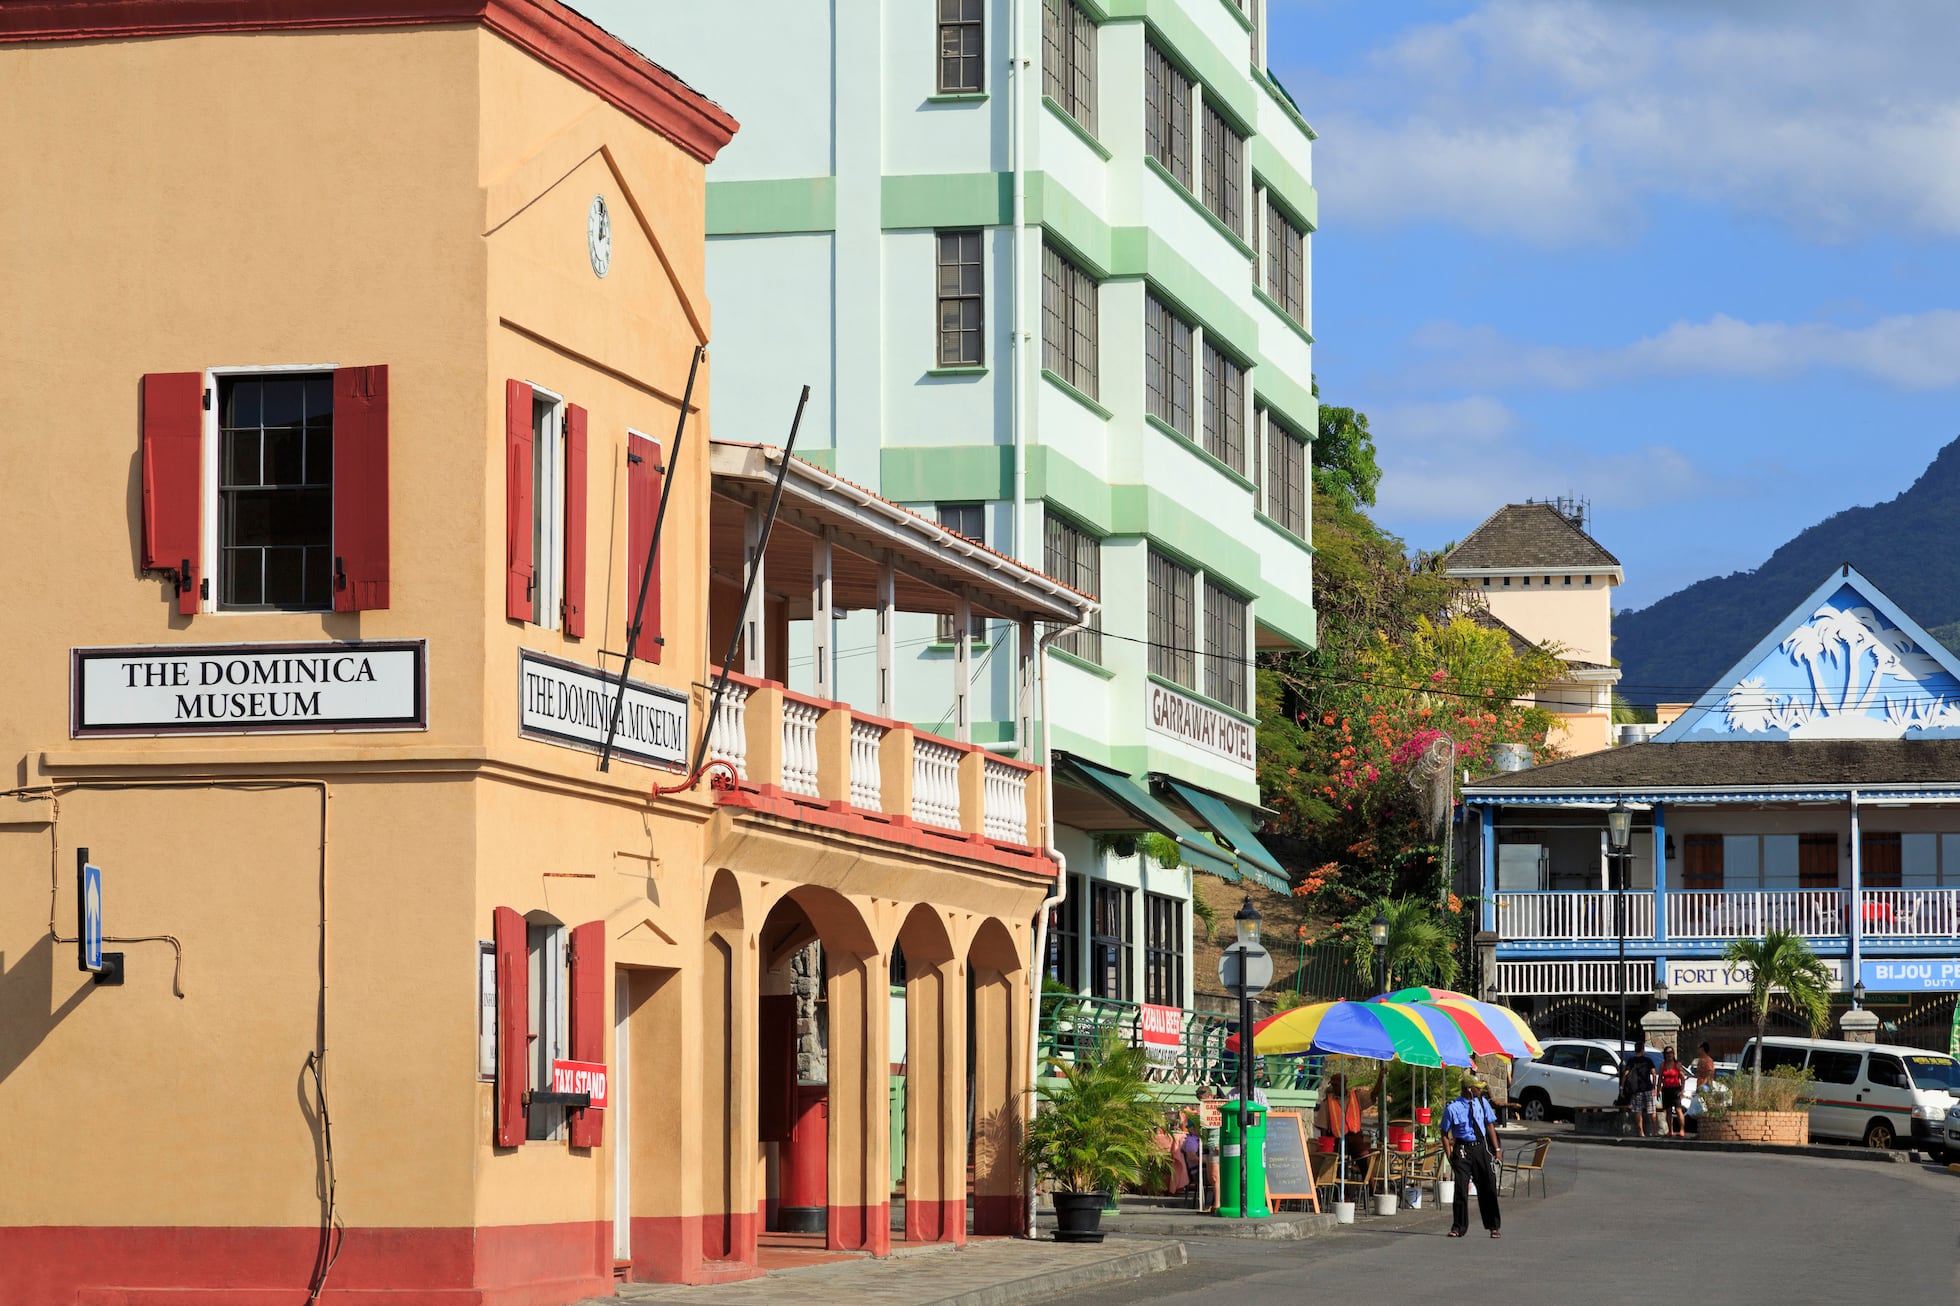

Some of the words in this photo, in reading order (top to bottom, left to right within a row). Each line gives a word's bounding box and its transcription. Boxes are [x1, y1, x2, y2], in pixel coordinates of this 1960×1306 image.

[121, 661, 190, 688] THE
[199, 657, 377, 686] DOMINICA
[175, 691, 322, 719] MUSEUM
[526, 672, 555, 718] THE
[558, 681, 626, 737] DOMINICA
[628, 701, 682, 751] MUSEUM
[1152, 688, 1217, 746] GARRAWAY
[1218, 716, 1252, 762] HOTEL
[1674, 968, 1717, 986] FORT
[1876, 964, 1932, 979] BIJOU
[1924, 979, 1956, 987] DUTY
[554, 1068, 574, 1094] TAXI
[575, 1070, 606, 1100] STAND
